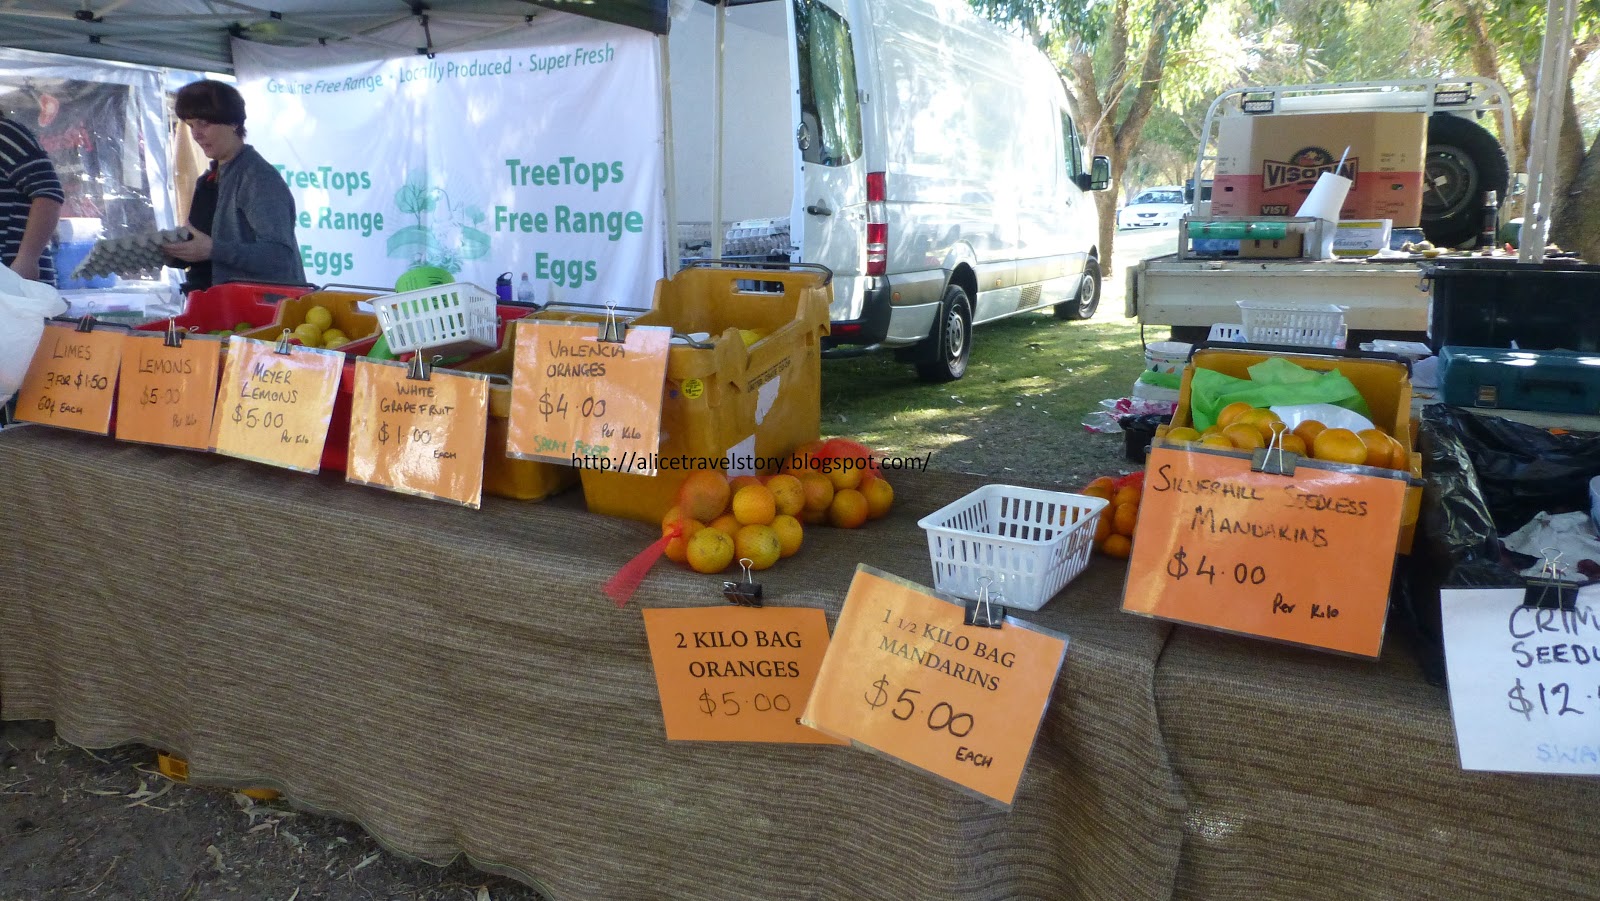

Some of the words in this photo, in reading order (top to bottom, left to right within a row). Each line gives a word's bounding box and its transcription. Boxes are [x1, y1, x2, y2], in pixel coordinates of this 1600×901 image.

[314, 80, 341, 94] Free
[342, 75, 384, 92] Range
[447, 56, 512, 77] Produced
[529, 53, 571, 74] Super
[575, 43, 614, 66] Fresh
[505, 156, 624, 192] TreeTops
[318, 206, 384, 238] Range
[495, 205, 549, 233] Free
[555, 205, 644, 242] Range
[300, 244, 354, 276] Eggs
[535, 252, 598, 289] Eggs
[53, 337, 91, 360] LIMES
[548, 339, 627, 358] VALENCIA
[139, 354, 192, 374] LEMONS
[251, 362, 292, 384] MEYER
[546, 362, 607, 378] ORANGES
[56, 374, 71, 386] FOR
[396, 382, 435, 398] WHITE
[241, 381, 298, 404] LEMONS
[60, 402, 83, 415] EACH
[232, 403, 284, 429] $5.00
[601, 422, 615, 438] Per
[433, 449, 457, 460] EACH
[1167, 546, 1266, 585] $4.00
[1272, 592, 1297, 614] Per
[674, 631, 688, 649] 2
[693, 630, 749, 648] KILO
[754, 630, 803, 649] BAG
[882, 608, 892, 624] 1
[896, 618, 917, 634] 1/2
[922, 623, 970, 651] KILO
[973, 641, 1016, 668] BAG
[688, 660, 800, 678] ORANGES
[877, 635, 1000, 692] MANDARINS
[698, 687, 791, 717] $5.00
[864, 673, 975, 738] $5.00
[955, 746, 994, 769] EACH
